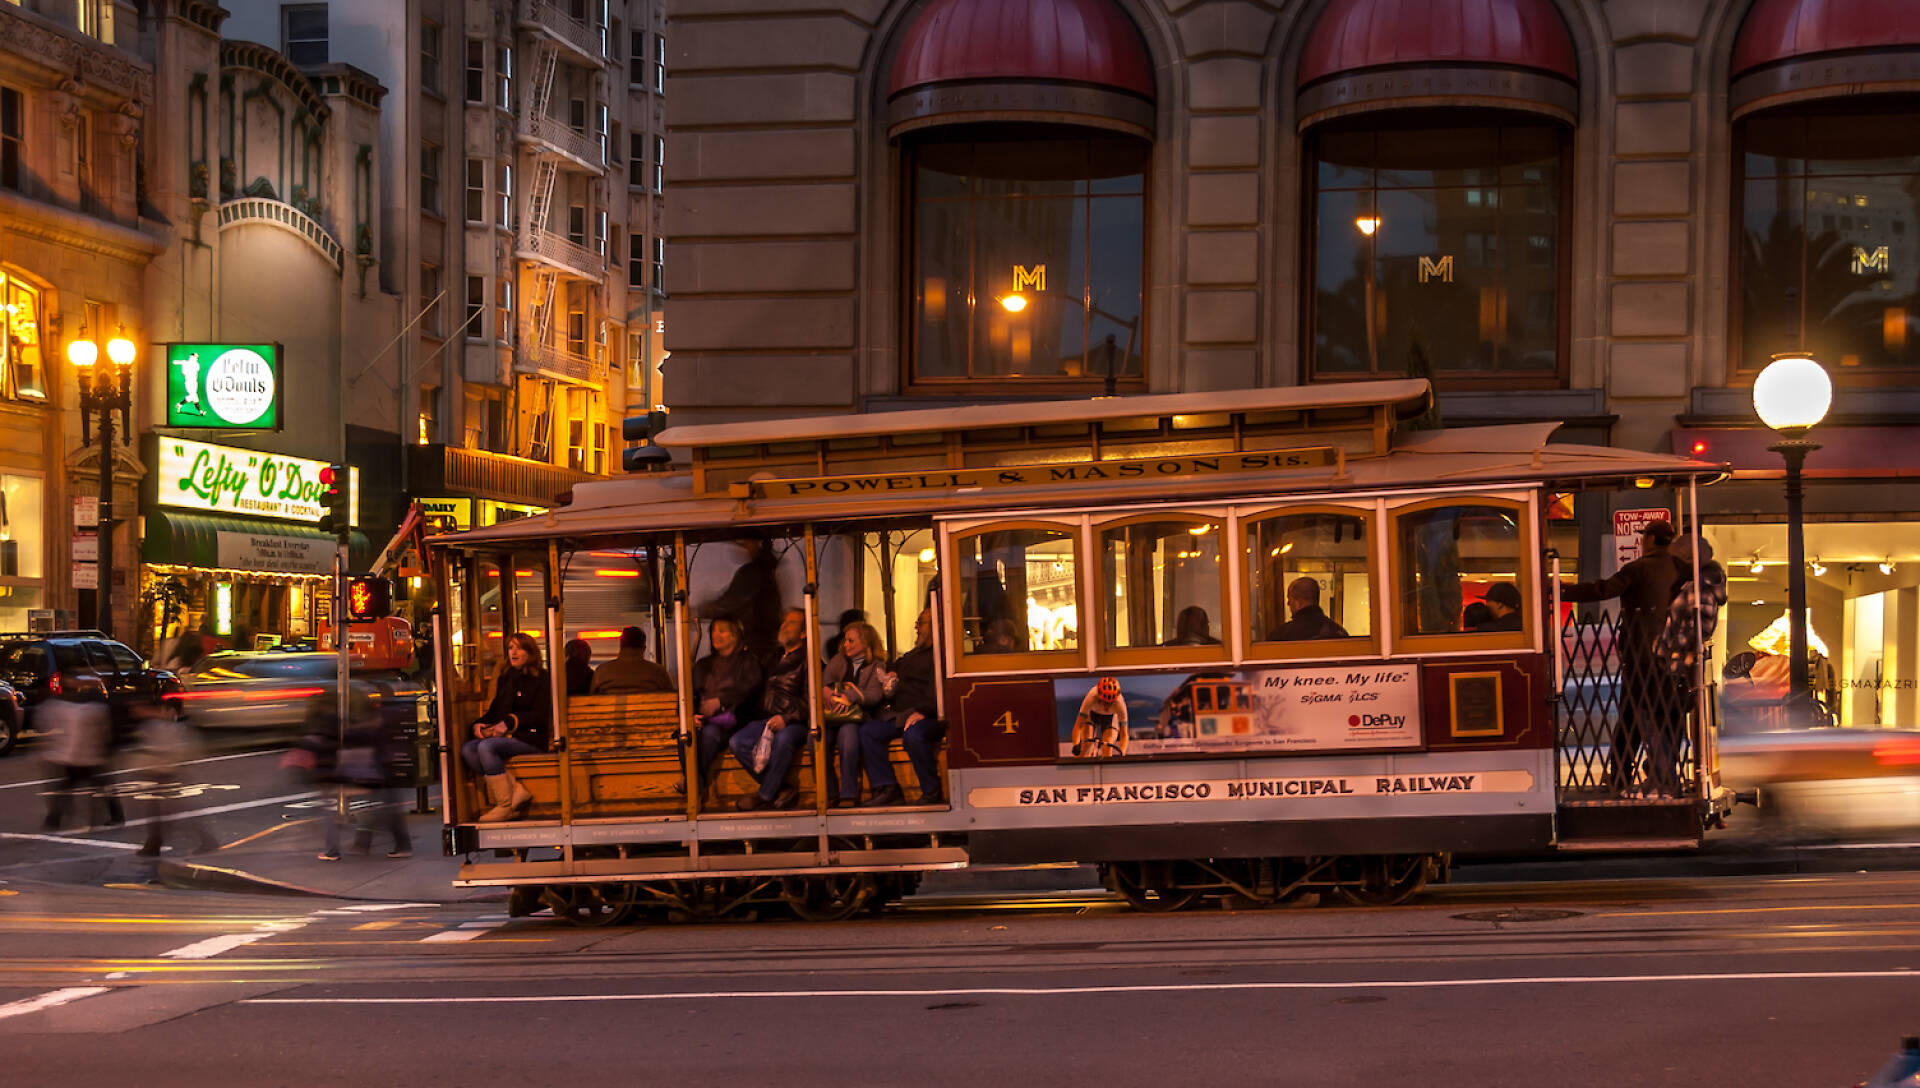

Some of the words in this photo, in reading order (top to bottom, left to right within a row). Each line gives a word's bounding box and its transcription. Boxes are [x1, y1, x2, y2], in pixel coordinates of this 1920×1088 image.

[1012, 264, 1046, 292] M
[1418, 256, 1454, 283] M
[787, 474, 978, 495] POWELL
[998, 470, 1028, 484] &
[1049, 458, 1220, 481] MASON
[1241, 454, 1309, 469] Sts.
[240, 498, 283, 513] RESTAURANT
[1618, 511, 1665, 522] TOW-AWAY
[1616, 523, 1630, 536] NO
[1264, 676, 1289, 689] My
[1293, 675, 1339, 686] knee.
[1345, 673, 1370, 686] My
[992, 710, 1020, 734] 4
[1362, 713, 1406, 728] DePuy
[1020, 787, 1068, 805] SAN
[1077, 783, 1211, 803] FRANCISCO
[1228, 779, 1353, 797] MUNICIPAL
[1376, 775, 1476, 794] RAILWAY
